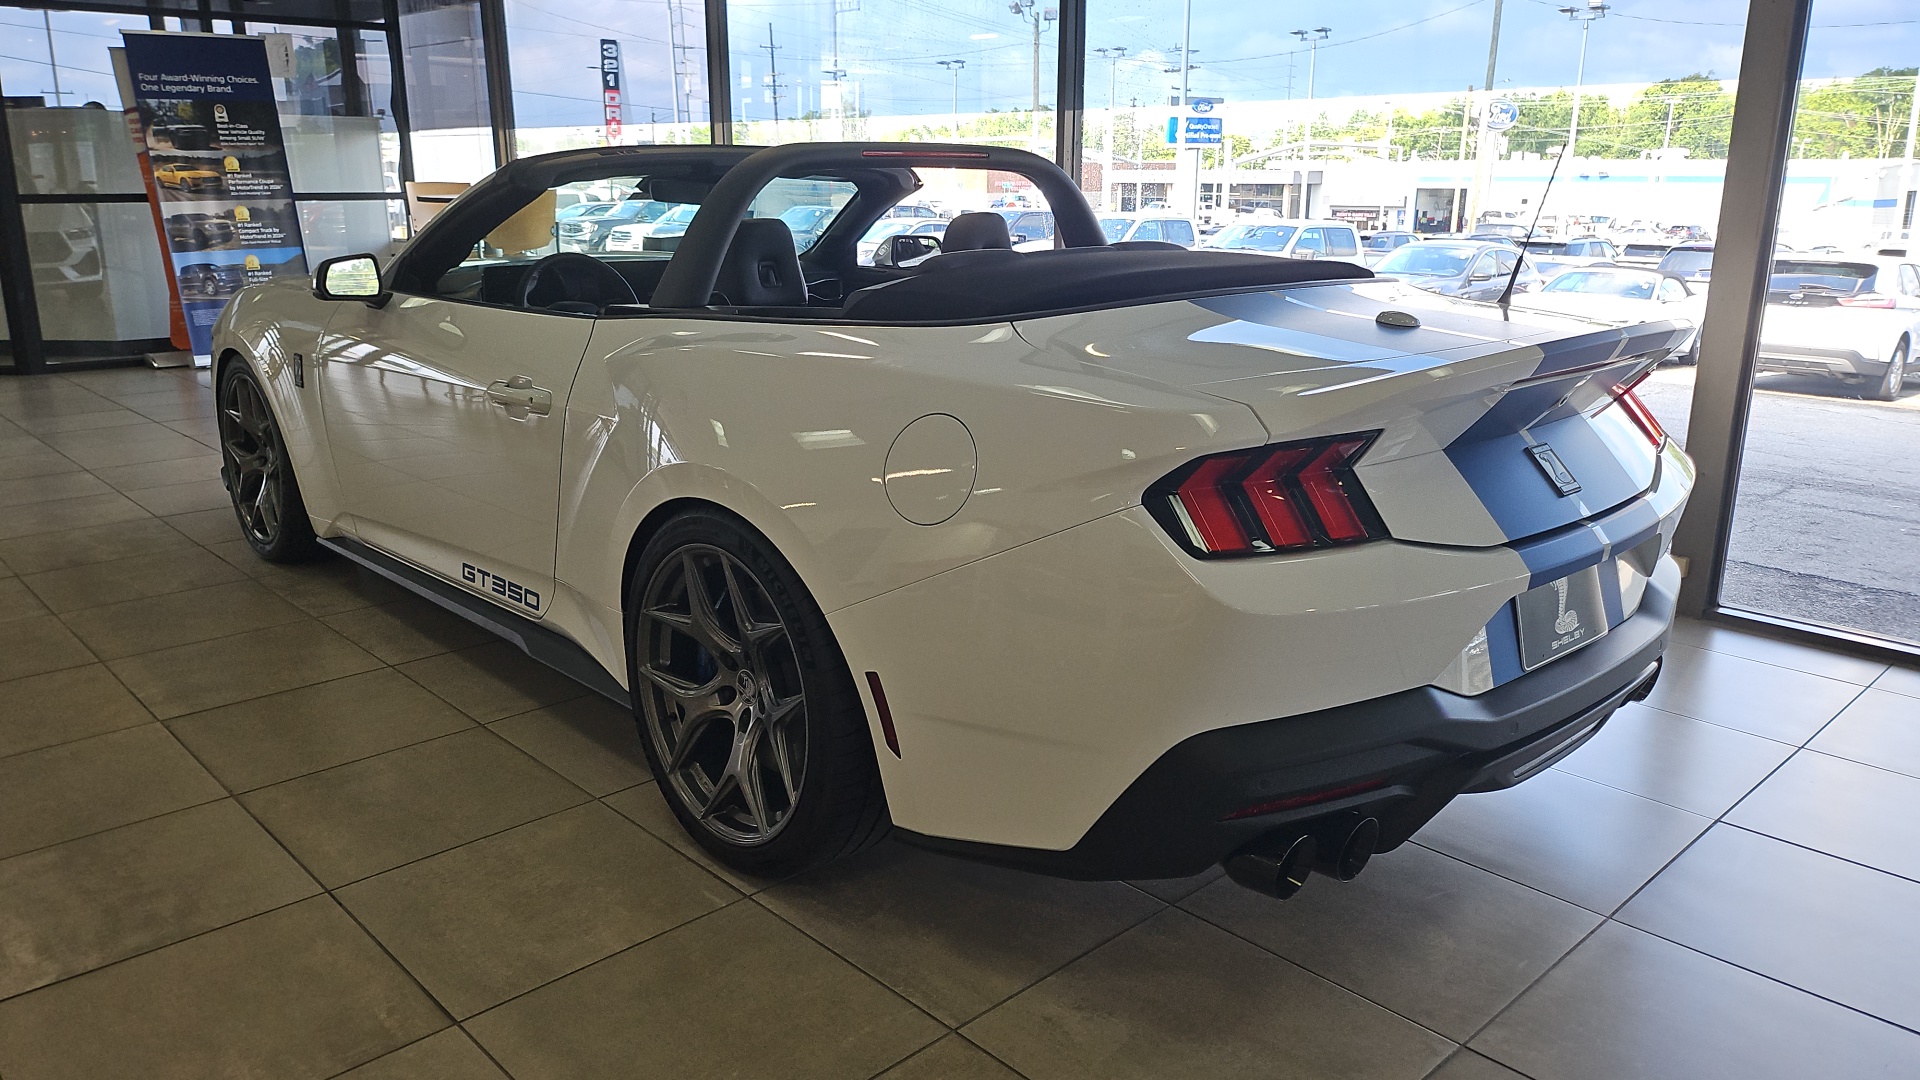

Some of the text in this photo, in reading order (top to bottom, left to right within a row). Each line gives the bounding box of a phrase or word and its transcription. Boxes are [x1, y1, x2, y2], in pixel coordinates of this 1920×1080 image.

[602, 43, 619, 88] 321
[138, 73, 259, 84] Four Award-Winning Choices.
[140, 83, 234, 94] One Legendary Brand.
[462, 562, 540, 611] GT350
[1551, 627, 1585, 650] SHELBY
